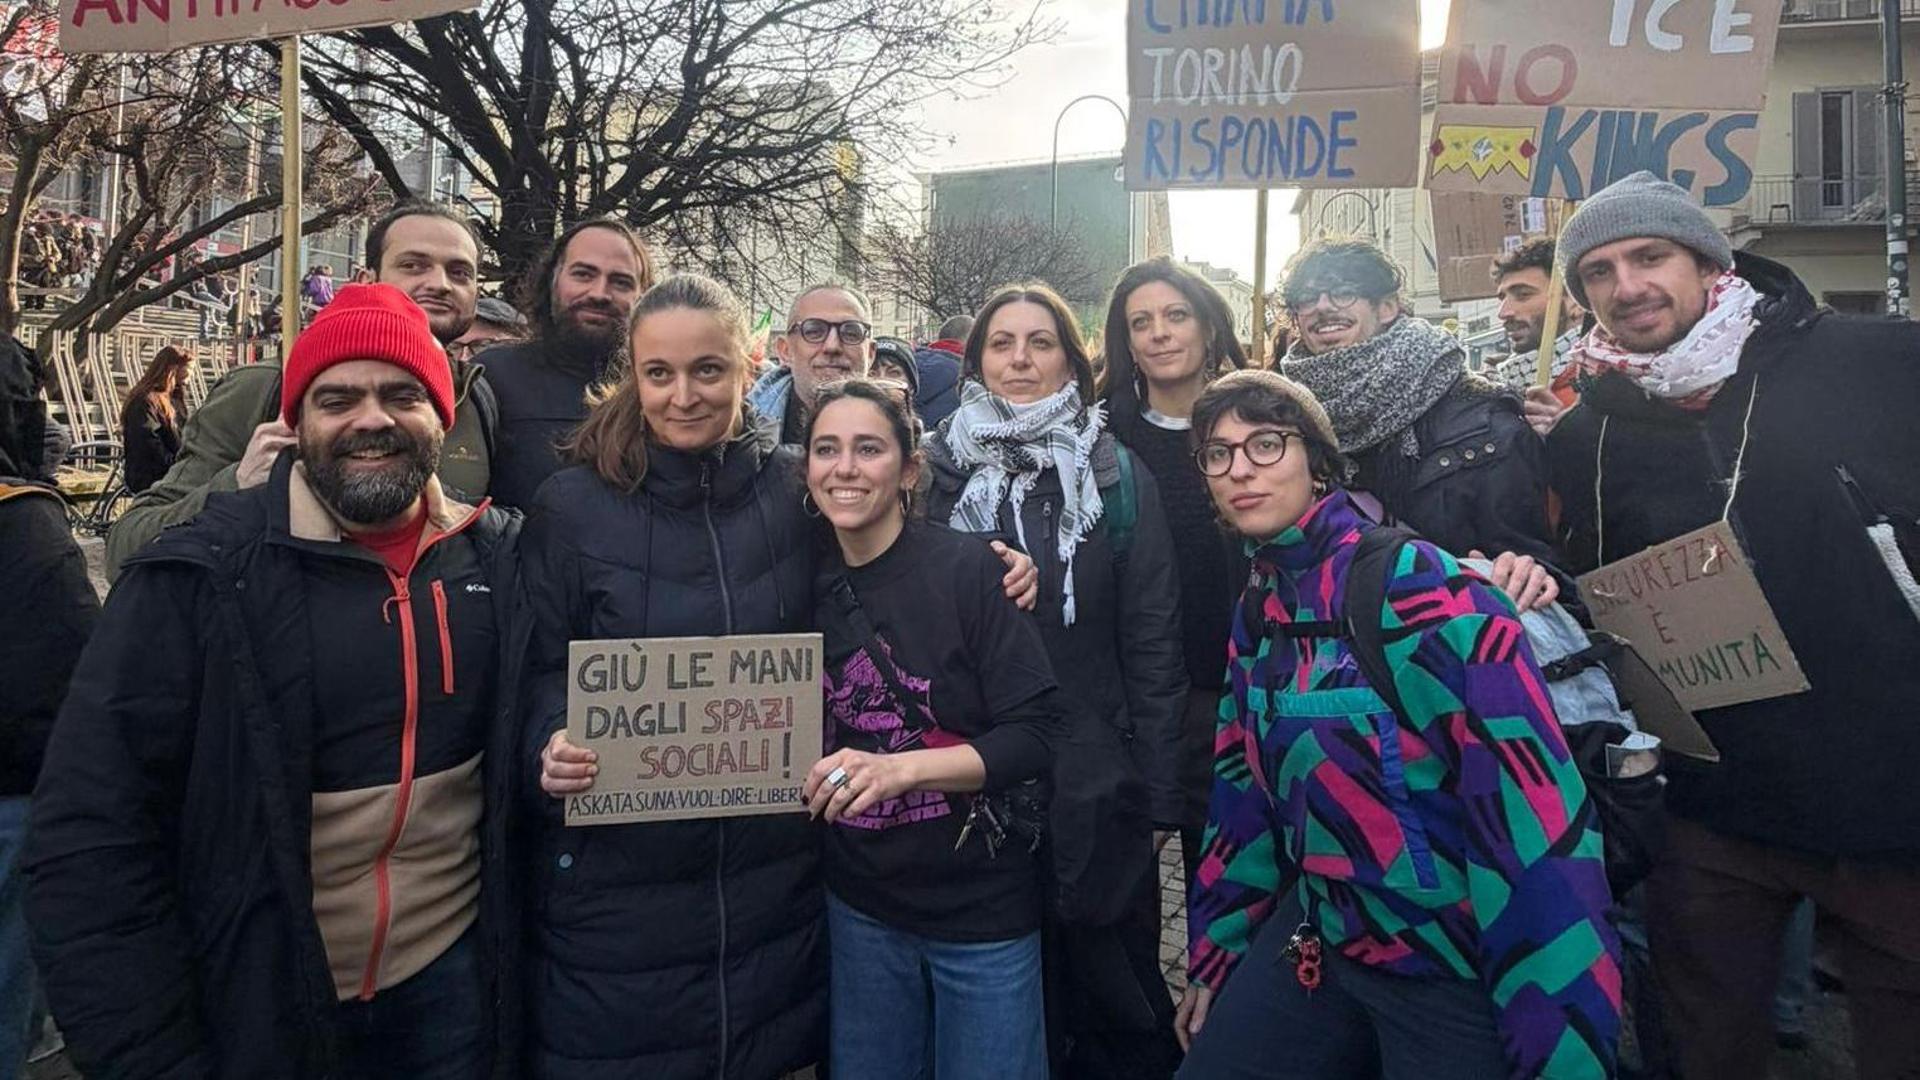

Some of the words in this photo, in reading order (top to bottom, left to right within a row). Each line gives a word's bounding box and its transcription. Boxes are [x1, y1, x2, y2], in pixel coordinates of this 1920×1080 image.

[1609, 0, 1755, 53] ICE
[1143, 42, 1303, 107] TORINO
[1453, 43, 1578, 106] NO
[1143, 110, 1358, 183] RISPONDE
[1528, 105, 1759, 207] KINGS
[1647, 604, 1675, 644] È
[577, 642, 648, 693] GIÙ
[667, 652, 714, 690] LE
[729, 648, 813, 685] MANI
[585, 701, 686, 740] DAGLI
[701, 696, 793, 734] SPAZI
